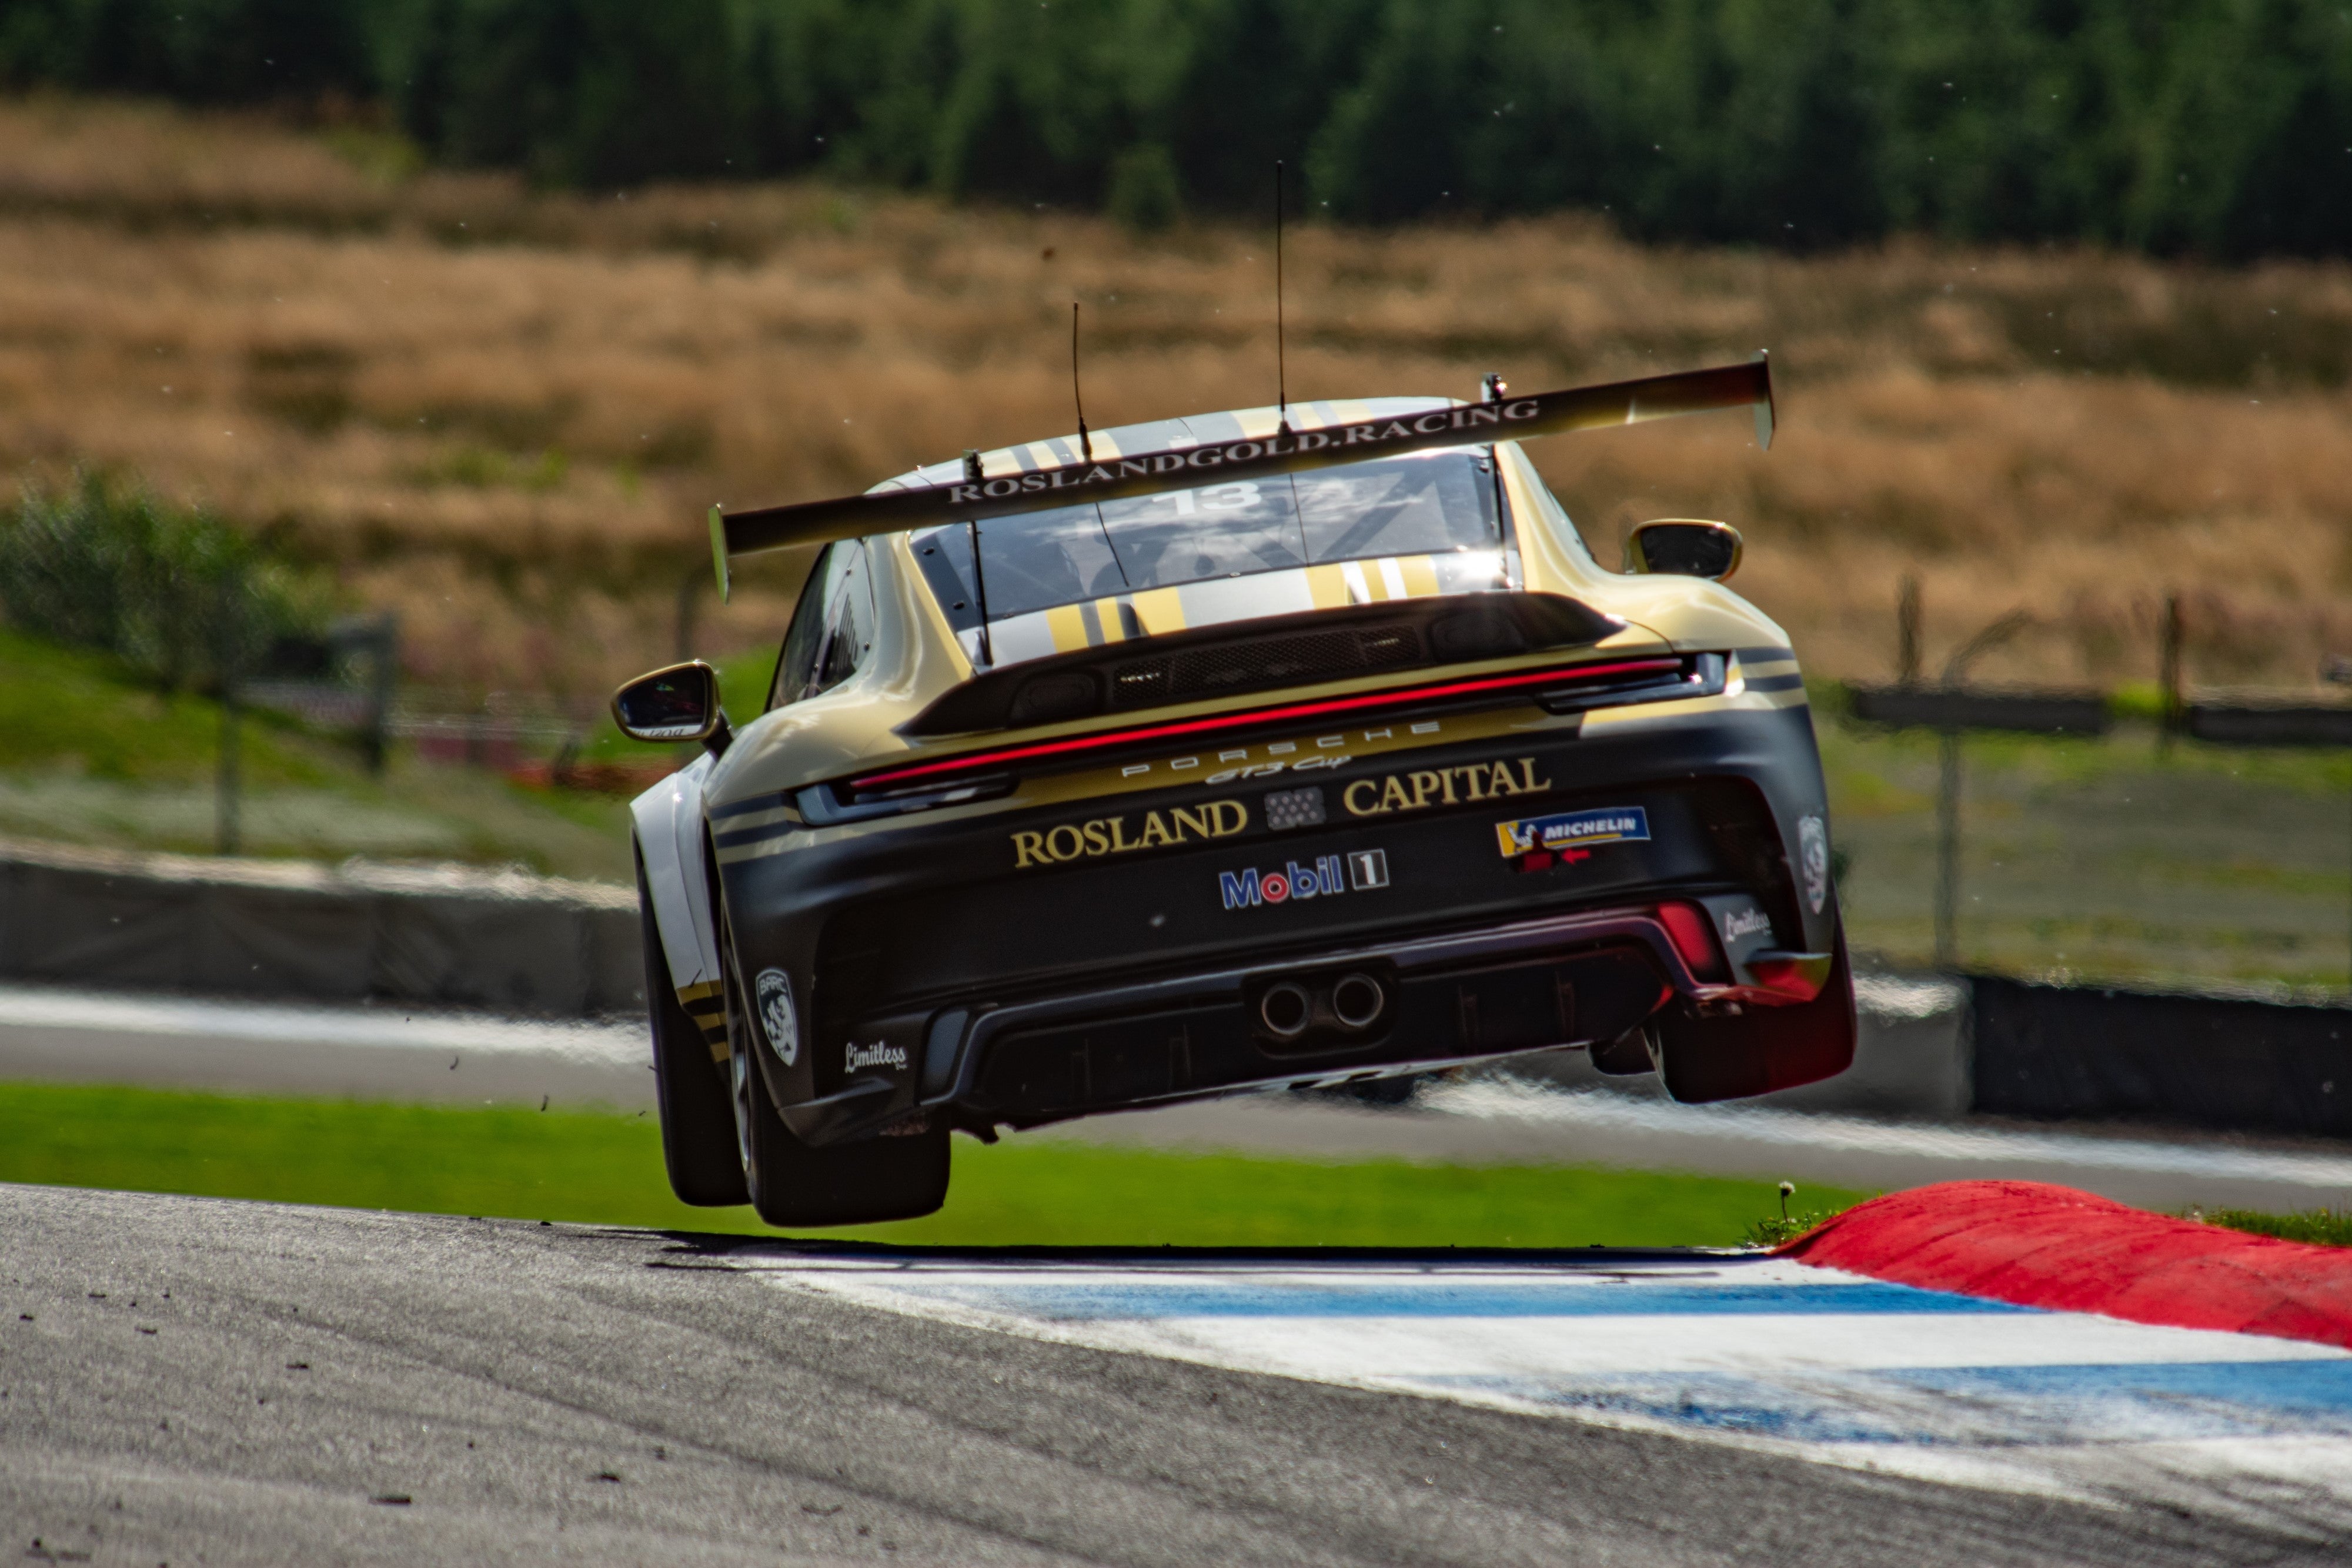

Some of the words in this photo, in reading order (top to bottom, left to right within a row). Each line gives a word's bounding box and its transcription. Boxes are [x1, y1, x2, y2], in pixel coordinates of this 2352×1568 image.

[947, 399, 1540, 503] ROSLANDGOLD.RACING
[1151, 482, 1262, 516] 13
[1121, 721, 1441, 777] PORSCHE
[1205, 761, 1285, 785] GT3
[1010, 799, 1248, 869] ROSLAND
[1342, 757, 1552, 816] CAPITAL
[1544, 817, 1637, 839] MICHELIN
[1218, 854, 1344, 910] Mobil
[844, 1040, 906, 1074] Limitless
